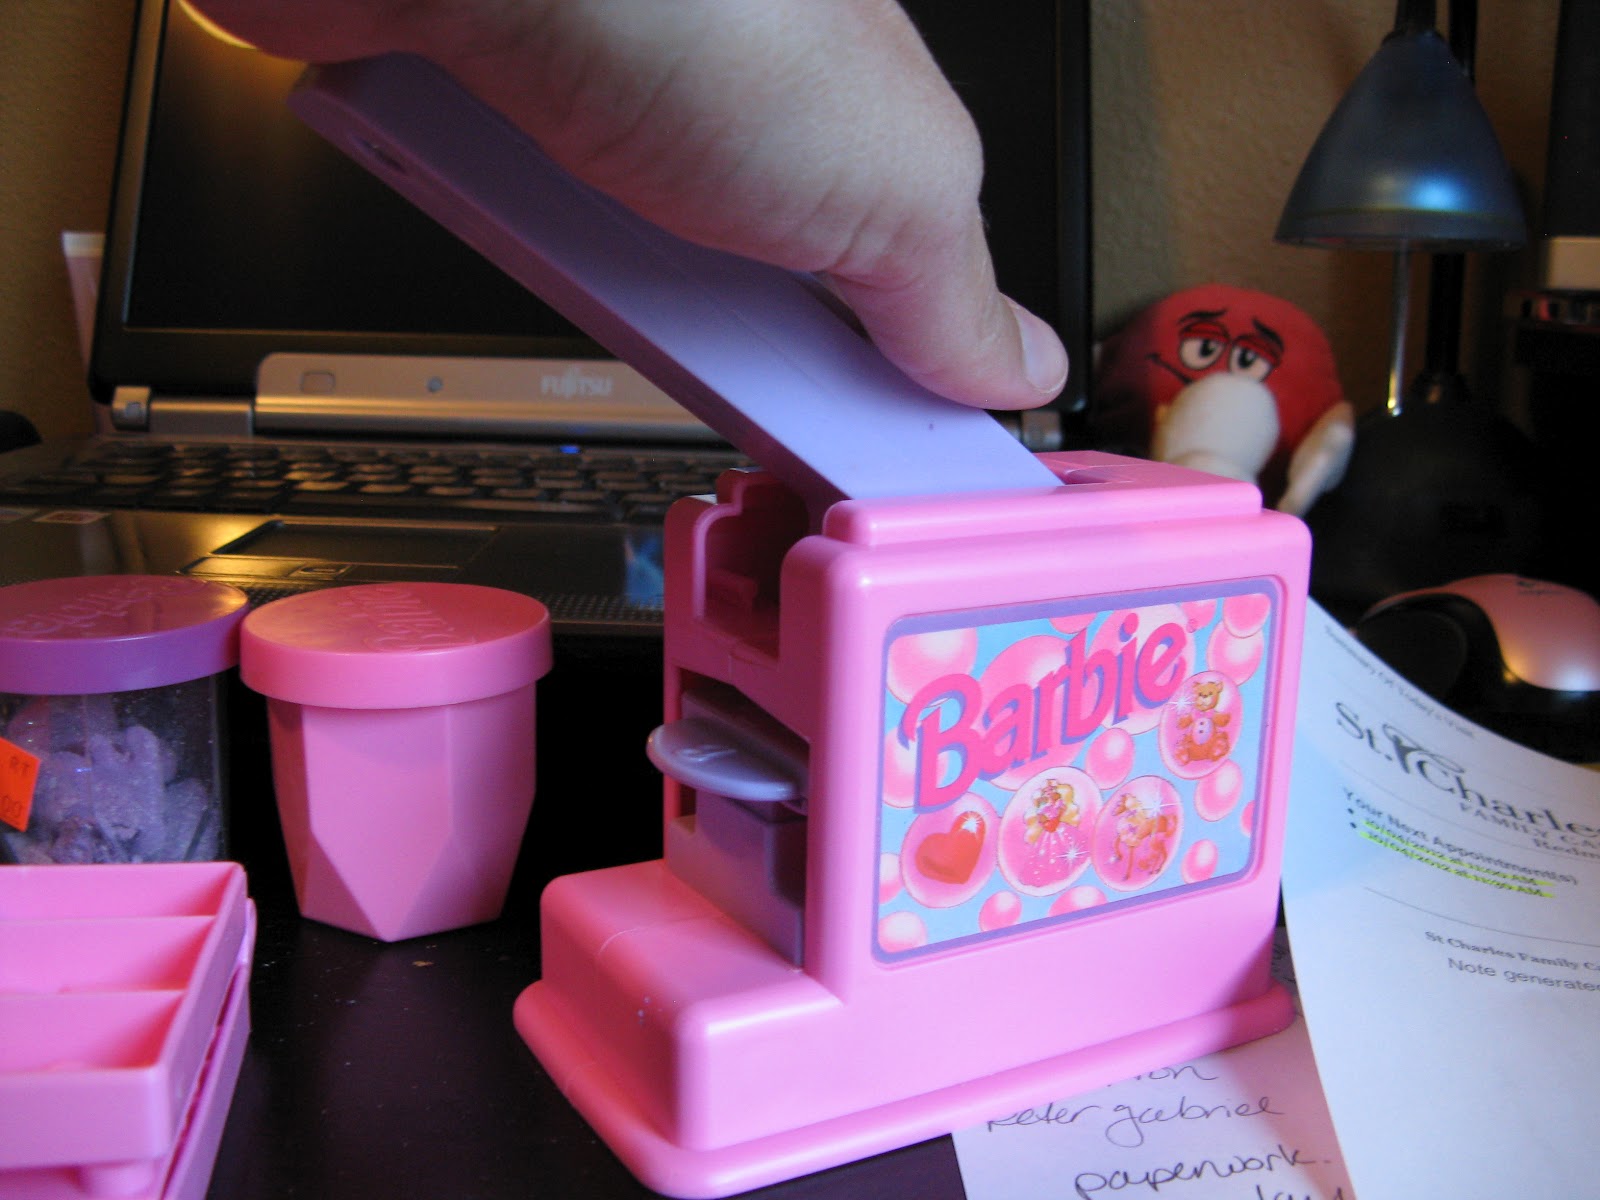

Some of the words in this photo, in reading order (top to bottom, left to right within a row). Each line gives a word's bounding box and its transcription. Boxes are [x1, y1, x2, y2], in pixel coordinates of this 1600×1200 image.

[898, 613, 1188, 814] Barbie
[1335, 702, 1393, 763] St.
[1416, 759, 1600, 838] Charle
[1343, 786, 1383, 819] Your
[1425, 930, 1445, 944] St
[1447, 937, 1516, 960] Charles
[1517, 952, 1580, 971] Family
[1447, 957, 1497, 977] Note
